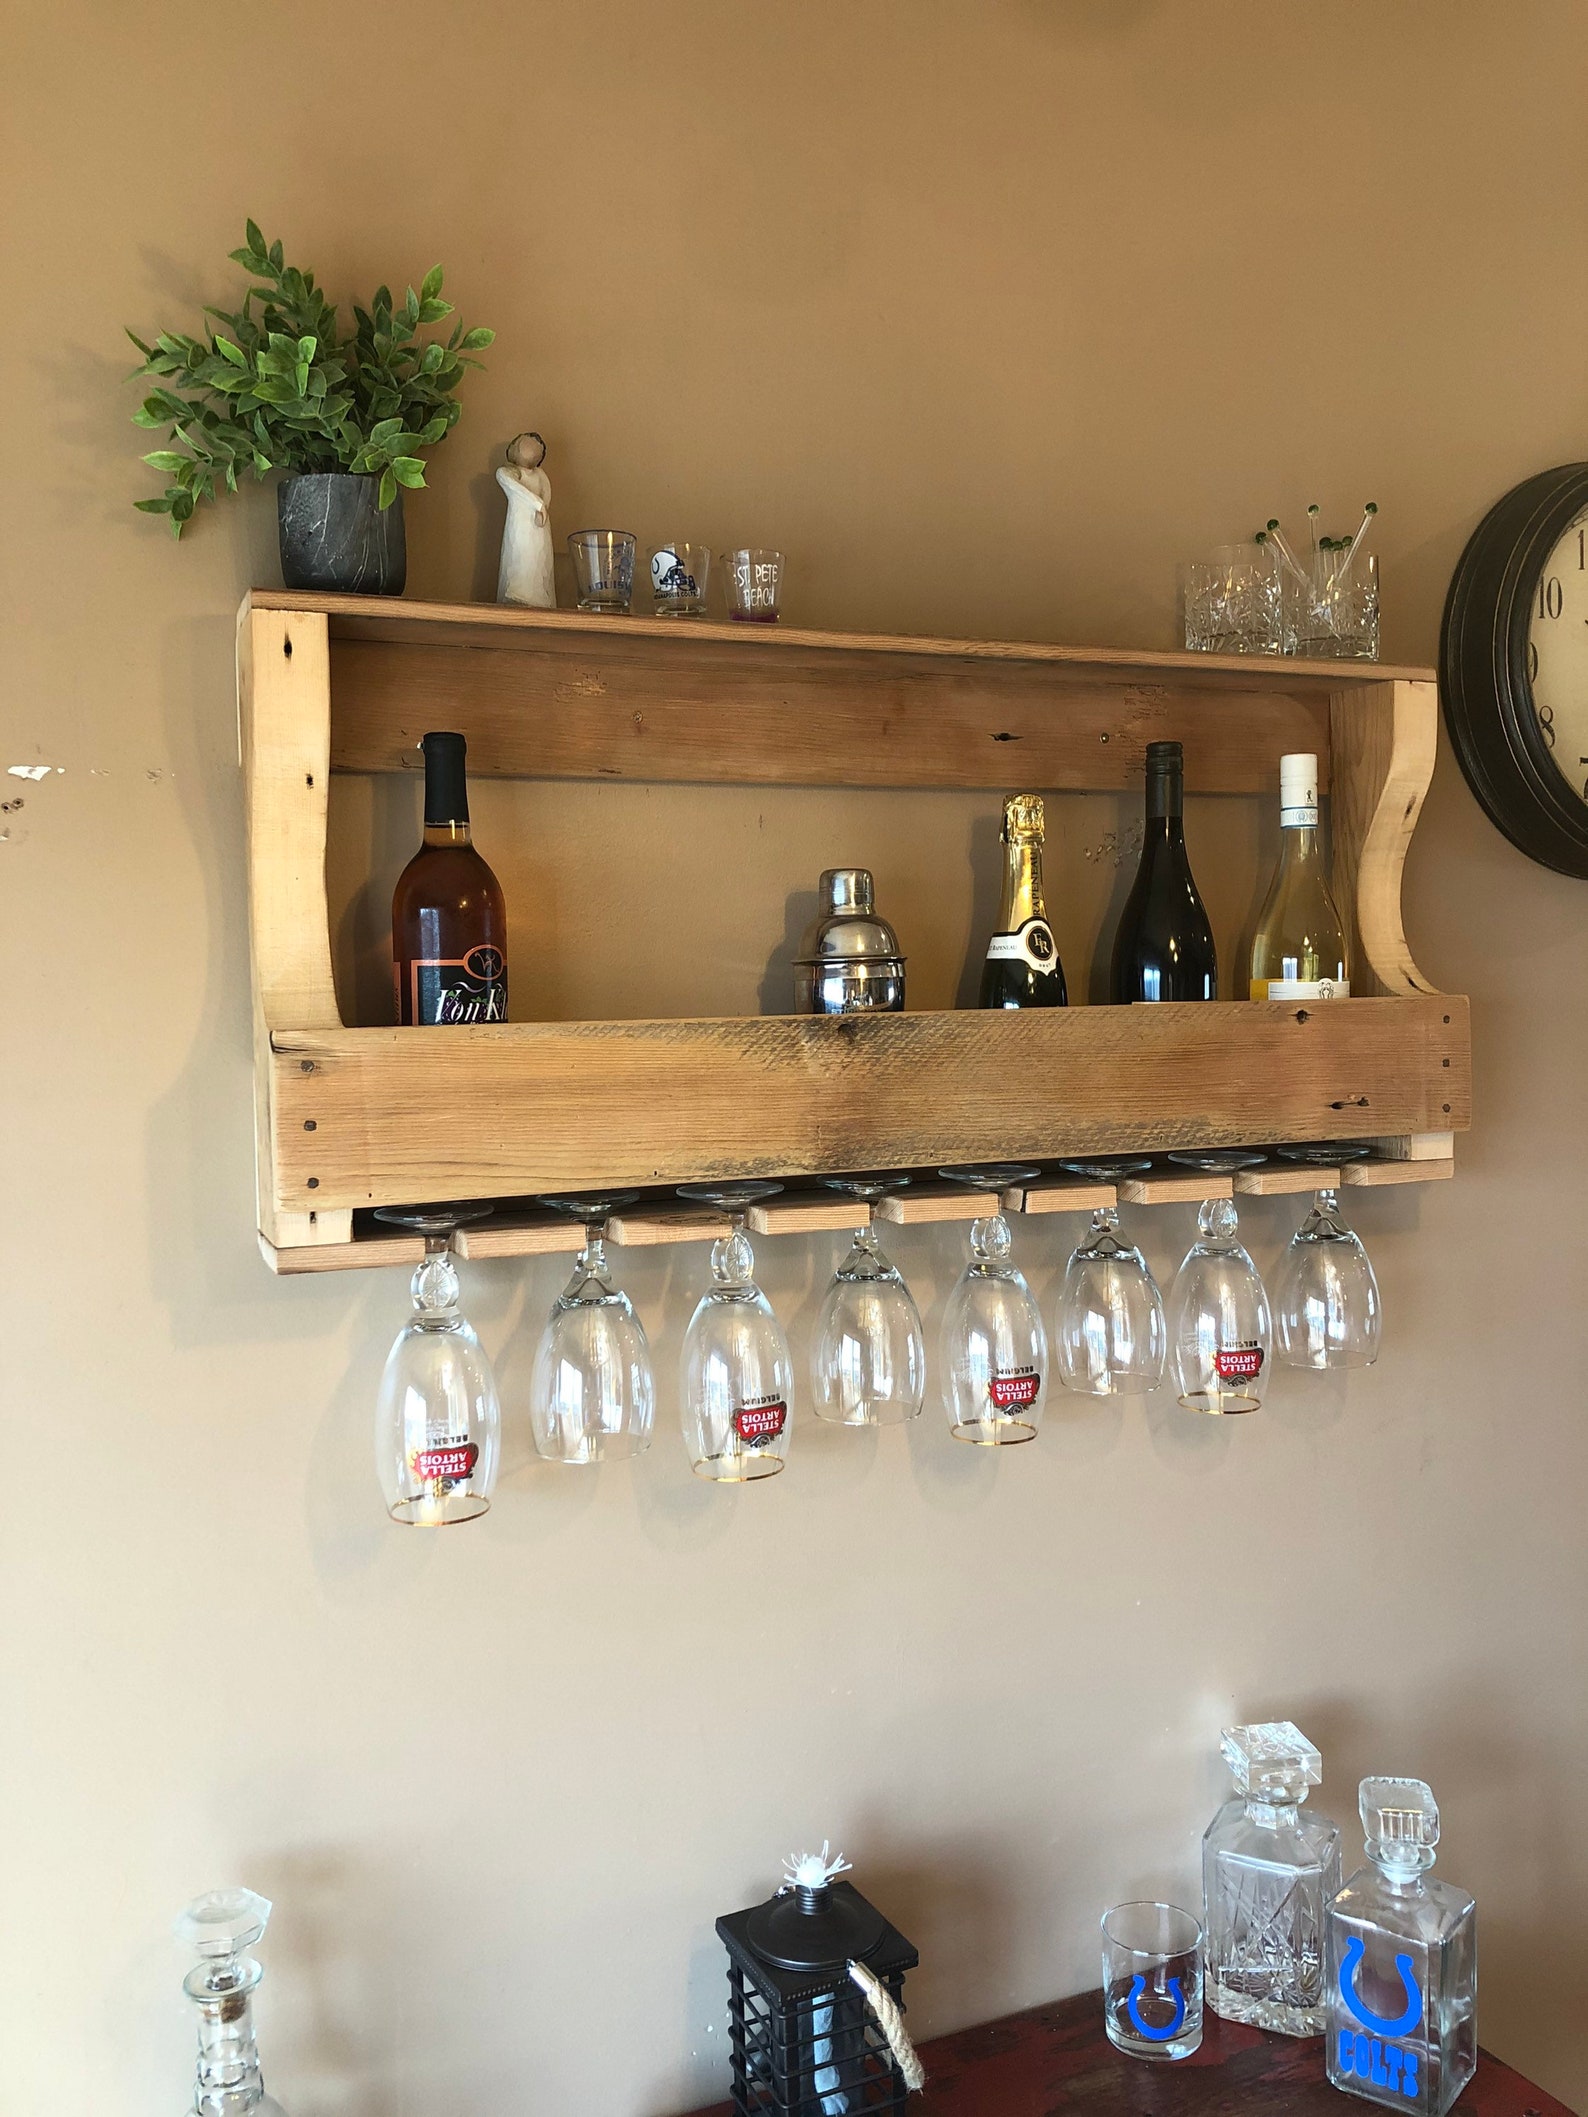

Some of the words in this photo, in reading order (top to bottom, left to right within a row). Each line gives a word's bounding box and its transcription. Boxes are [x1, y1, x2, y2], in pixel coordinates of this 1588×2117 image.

[755, 563, 778, 584] PETE
[743, 586, 775, 607] BEACH
[1539, 576, 1563, 619] 10
[1030, 849, 1040, 916] RAPENEAU
[1220, 1355, 1257, 1364] ARTOIS
[996, 1365, 1034, 1375] BELGIUM
[1220, 1363, 1256, 1372] STELLA
[996, 1381, 1034, 1392] ARTOIS
[741, 1393, 781, 1406] BELGIUM
[996, 1390, 1033, 1401] STELLA
[741, 1409, 780, 1424] ARTOIS
[742, 1419, 780, 1434] STELLA
[419, 1451, 468, 1466] ARTOIS
[420, 1462, 467, 1476] STELLA
[1338, 2029, 1419, 2098] COLTS
